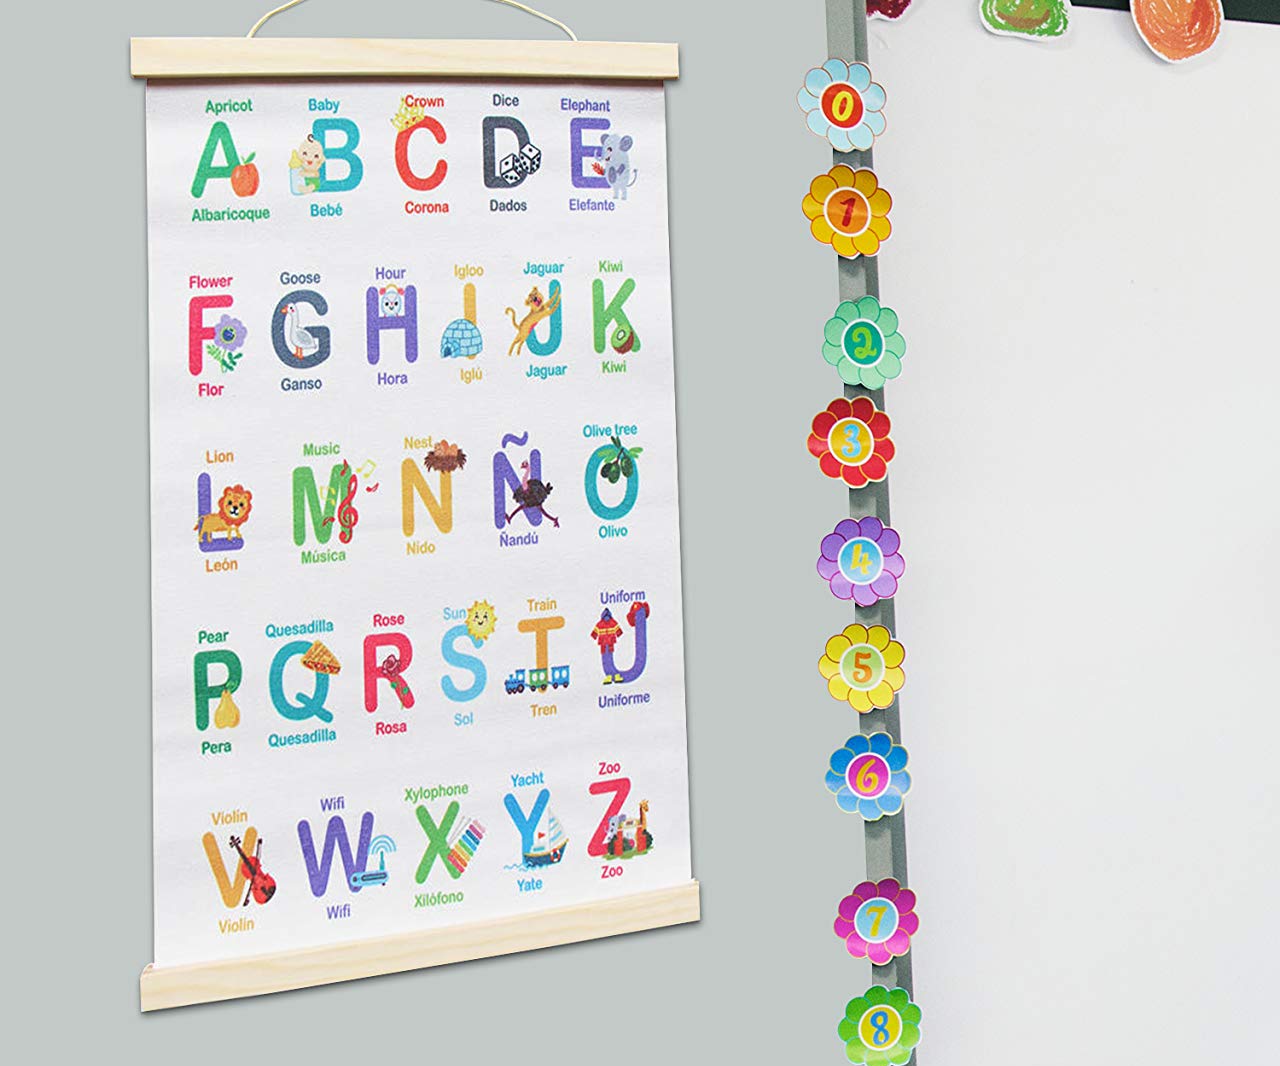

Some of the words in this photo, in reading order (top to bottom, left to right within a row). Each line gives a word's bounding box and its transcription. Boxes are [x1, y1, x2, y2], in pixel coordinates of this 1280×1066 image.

[205, 99, 253, 116] Apricot
[308, 98, 340, 114] Baby
[405, 94, 444, 109] Crown
[493, 94, 519, 106] Dice
[561, 98, 610, 113] Elephant
[832, 91, 854, 122] 0
[191, 121, 249, 198] A
[311, 117, 364, 192] B
[394, 115, 447, 191] C
[482, 116, 530, 189] D
[570, 118, 611, 189] E
[310, 203, 343, 217] Bebé
[405, 201, 449, 214] Corona
[490, 199, 527, 211] Dados
[569, 198, 615, 212] Elefante
[839, 197, 856, 227] 1
[192, 207, 270, 222] Albaricoque
[376, 267, 406, 280] Hour
[454, 264, 483, 280] Igloo
[523, 262, 564, 277] Jaguar
[599, 261, 623, 272] Kiwi
[189, 275, 233, 289] Flower
[280, 272, 320, 285] Goose
[366, 284, 418, 364] H
[525, 279, 561, 356] J
[592, 277, 641, 355] K
[188, 294, 233, 376] F
[271, 289, 331, 369] G
[852, 326, 877, 357] 2
[526, 365, 567, 380] Jaguar
[602, 360, 626, 373] Kiwi
[378, 373, 407, 385] Hora
[461, 368, 482, 384] Iglú
[199, 383, 224, 397] Flor
[281, 378, 322, 391] Ganso
[582, 423, 611, 437] Olive
[614, 423, 637, 436] tree
[404, 436, 433, 450] Nest
[841, 423, 861, 458] 3
[206, 450, 234, 464] Lion
[303, 442, 340, 456] Music
[492, 432, 543, 529] Ñ
[584, 442, 639, 521] O
[292, 464, 352, 546] M
[400, 458, 453, 537] N
[197, 472, 244, 552] L
[499, 531, 539, 548] Ñandú
[599, 525, 628, 539] Olivo
[407, 541, 435, 554] Nido
[300, 548, 346, 564] Música
[850, 543, 872, 577] 4
[206, 558, 238, 572] León
[527, 598, 557, 612] Train
[599, 590, 646, 605] Uniform
[373, 614, 404, 627] Rose
[443, 606, 466, 621] Sun
[198, 630, 229, 644] Pear
[265, 619, 334, 641] Quesadilla
[601, 606, 647, 685] U
[517, 616, 565, 694] T
[440, 624, 487, 703] S
[852, 652, 872, 682] 5
[363, 632, 415, 714] R
[269, 640, 333, 723] Q
[193, 649, 243, 732] P
[599, 693, 650, 708] Uniforme
[530, 704, 557, 717] Tren
[455, 713, 473, 726] Sol
[376, 722, 407, 735] Rosa
[268, 728, 336, 747] Quesadilla
[202, 741, 232, 755] Pera
[599, 762, 621, 775] Zoo
[856, 758, 878, 793] 6
[511, 772, 544, 787] Yacht
[404, 783, 469, 803] Xylophone
[320, 796, 344, 811] Wifi
[211, 809, 248, 825] Violin
[587, 777, 631, 858] Z
[503, 788, 550, 867] Y
[415, 800, 463, 884] X
[297, 811, 374, 898] W
[202, 826, 257, 909] V
[601, 865, 623, 878] Zoo
[517, 878, 542, 892] Yate
[415, 892, 463, 907] Xilófono
[327, 904, 350, 919] Wifi
[865, 906, 887, 937] 7
[871, 1010, 889, 1046] 8
